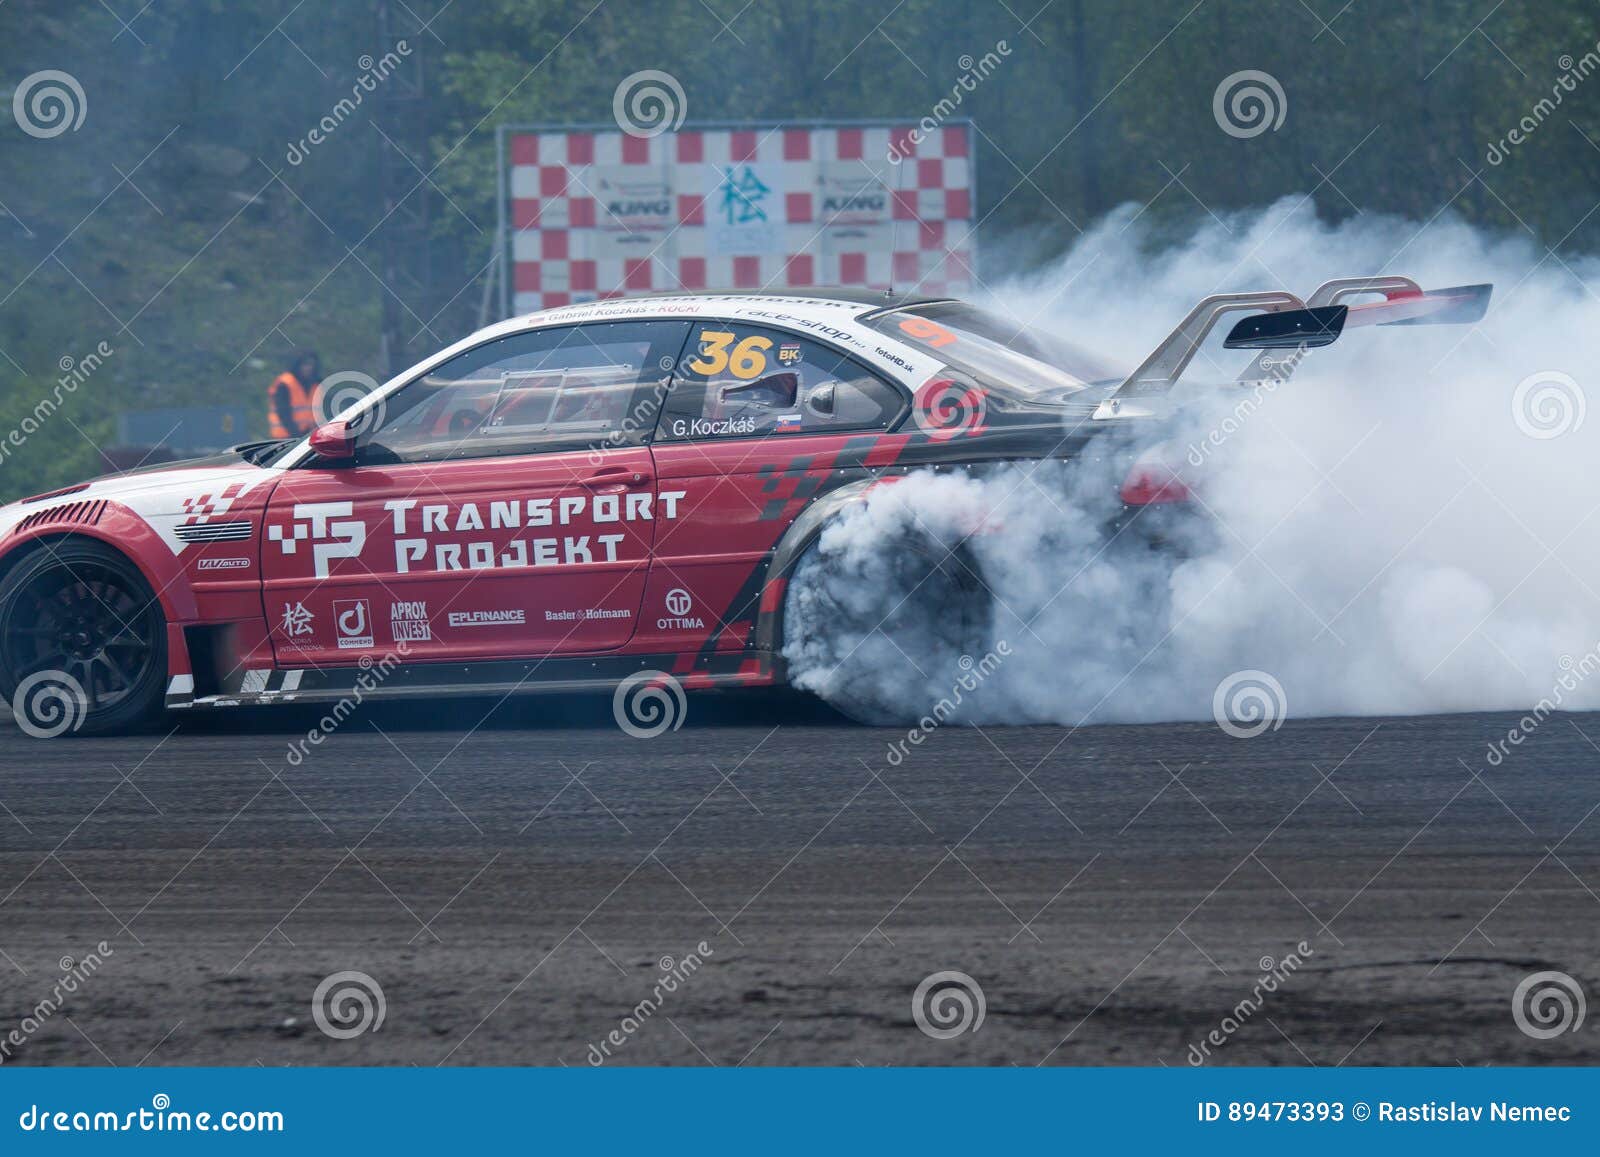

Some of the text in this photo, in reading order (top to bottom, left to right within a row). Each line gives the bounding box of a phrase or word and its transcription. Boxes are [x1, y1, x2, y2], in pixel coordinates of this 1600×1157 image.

[606, 200, 671, 217] KING
[822, 195, 884, 211] KING
[549, 309, 592, 322] Gabriel
[690, 331, 774, 379] 36
[779, 350, 800, 361] BK
[875, 347, 914, 372] fotoHD.sk
[673, 417, 755, 436] G.Koczkáš
[391, 602, 428, 620] APROX
[448, 610, 526, 627] EPLFINANCE
[392, 620, 431, 641] INVEST
[657, 617, 704, 629] OTTIMA
